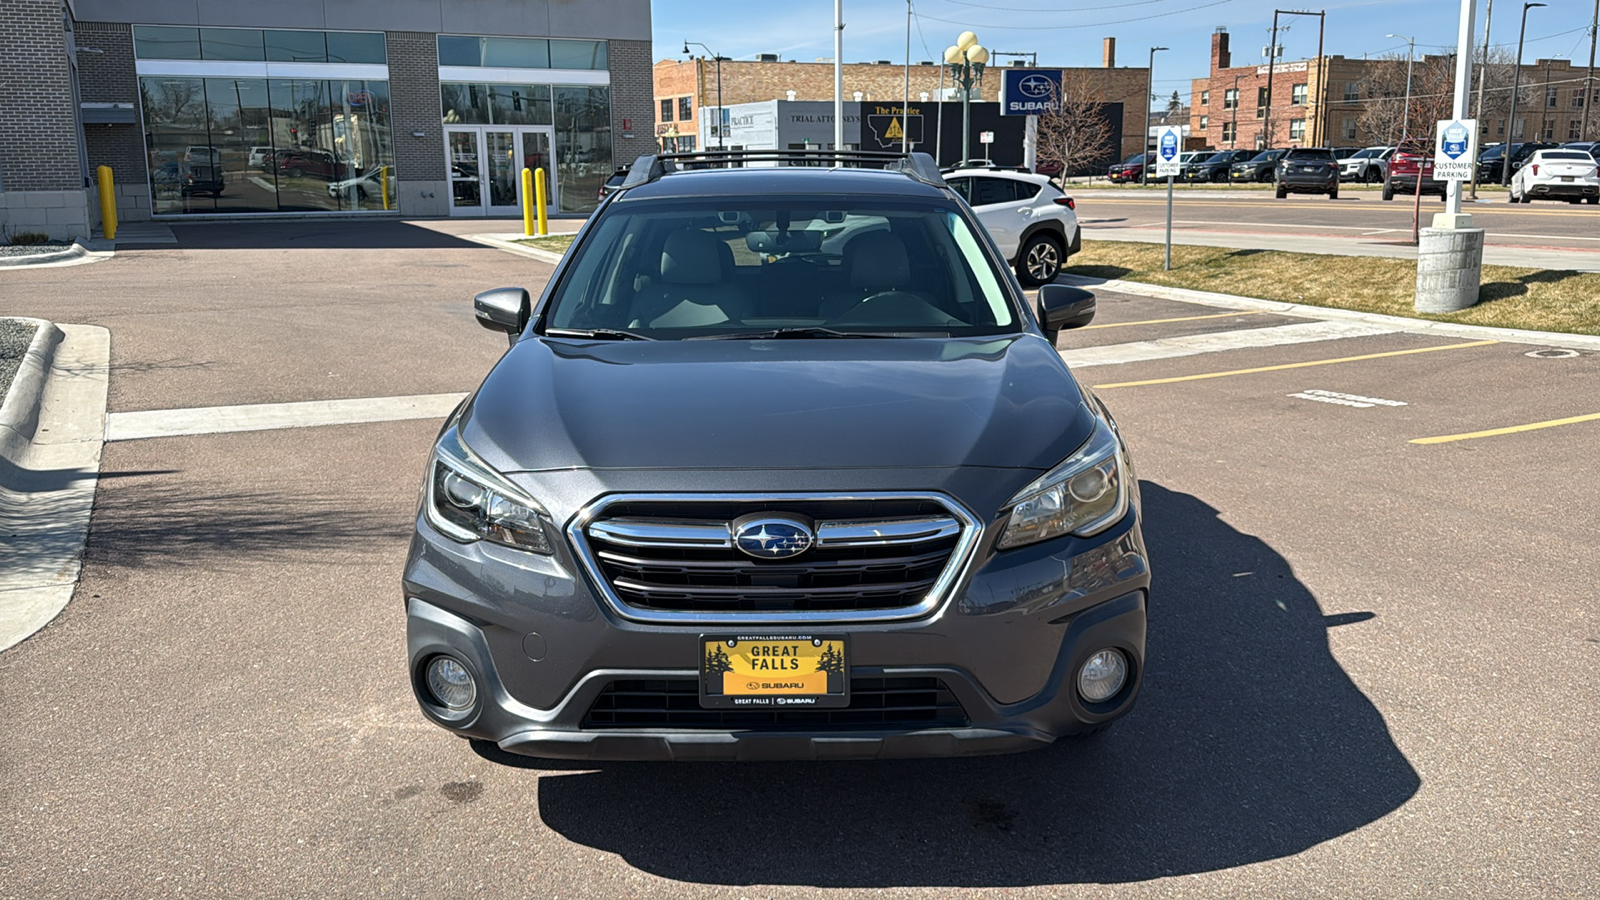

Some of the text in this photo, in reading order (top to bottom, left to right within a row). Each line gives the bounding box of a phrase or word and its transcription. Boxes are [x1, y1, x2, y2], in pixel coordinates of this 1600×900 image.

[875, 106, 920, 114] The Pratice
[1010, 102, 1059, 110] SUBARU
[731, 115, 754, 126] PRACTICE
[791, 114, 861, 123] TRIAL ATTONEYS
[1434, 162, 1473, 170] CUSTOMER
[751, 646, 799, 656] GREAT
[751, 658, 799, 670] FALLS
